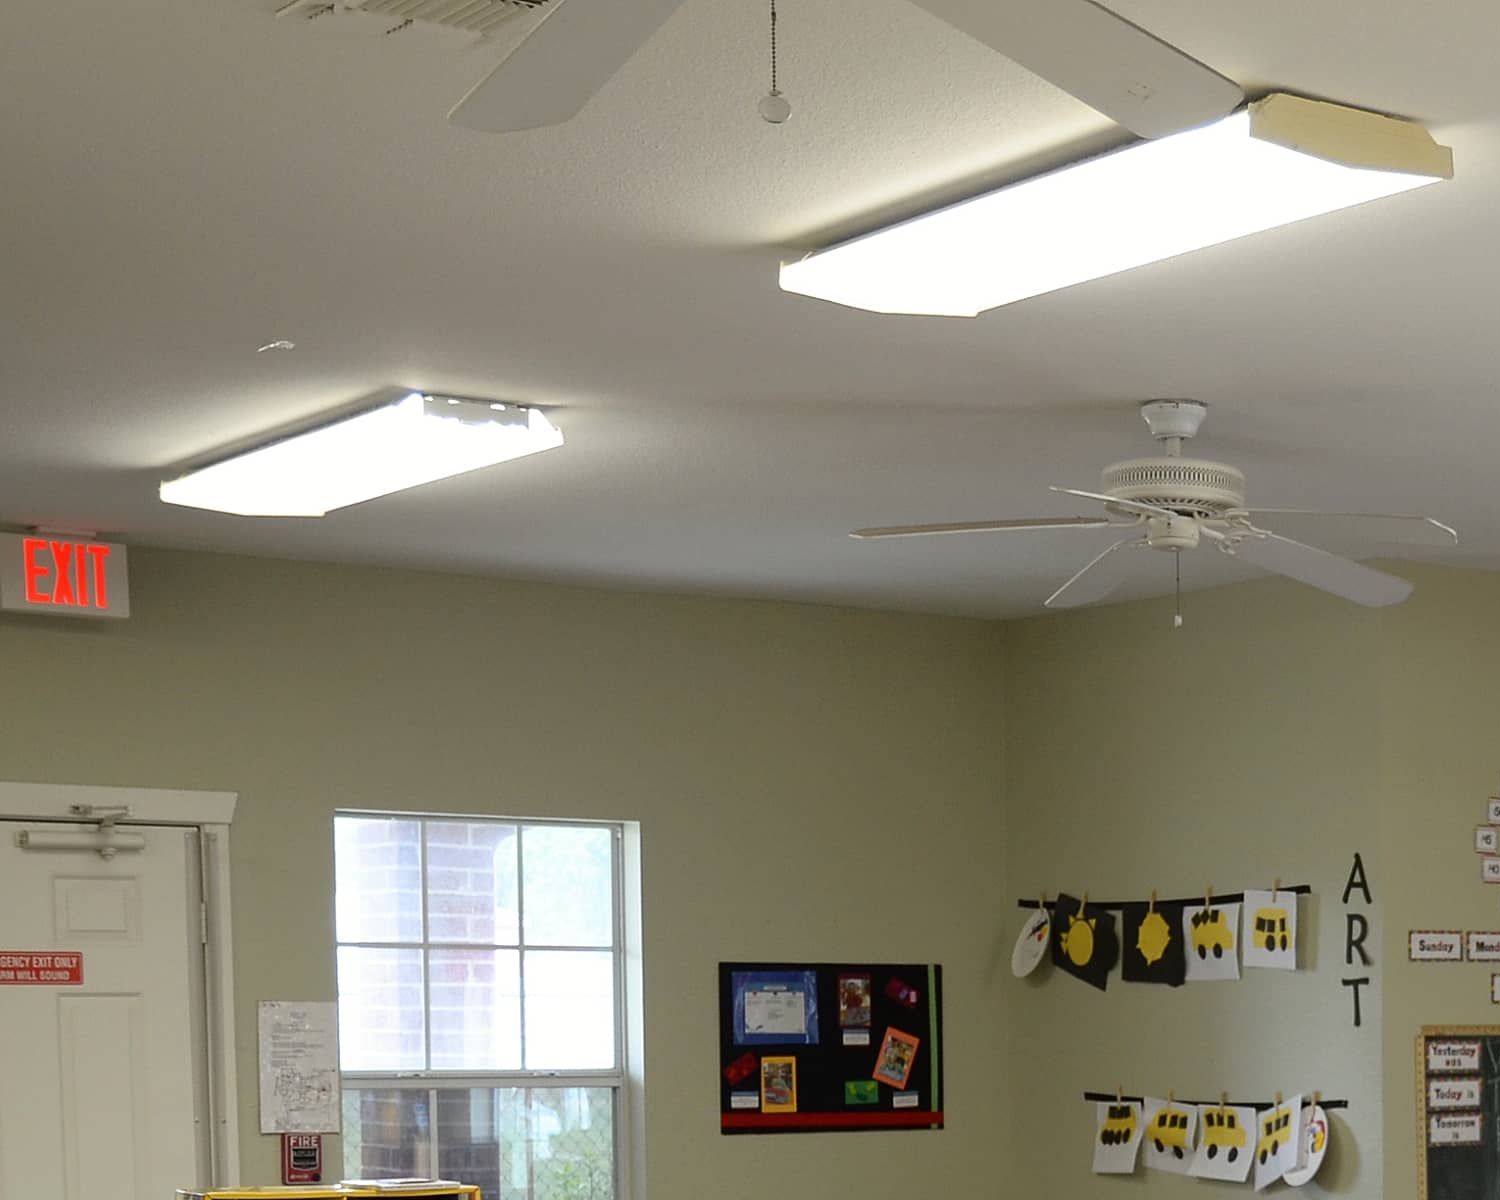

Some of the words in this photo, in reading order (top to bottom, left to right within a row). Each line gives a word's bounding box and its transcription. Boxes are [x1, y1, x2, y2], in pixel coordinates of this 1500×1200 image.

[23, 538, 111, 609] EXIT
[1341, 852, 1375, 1027] ART
[1418, 939, 1454, 954] Sunday
[1432, 1045, 1475, 1058] Yesterday
[1434, 1088, 1462, 1100] Today
[1436, 1118, 1475, 1129] Tomorrow
[290, 1136, 319, 1147] FIRE
